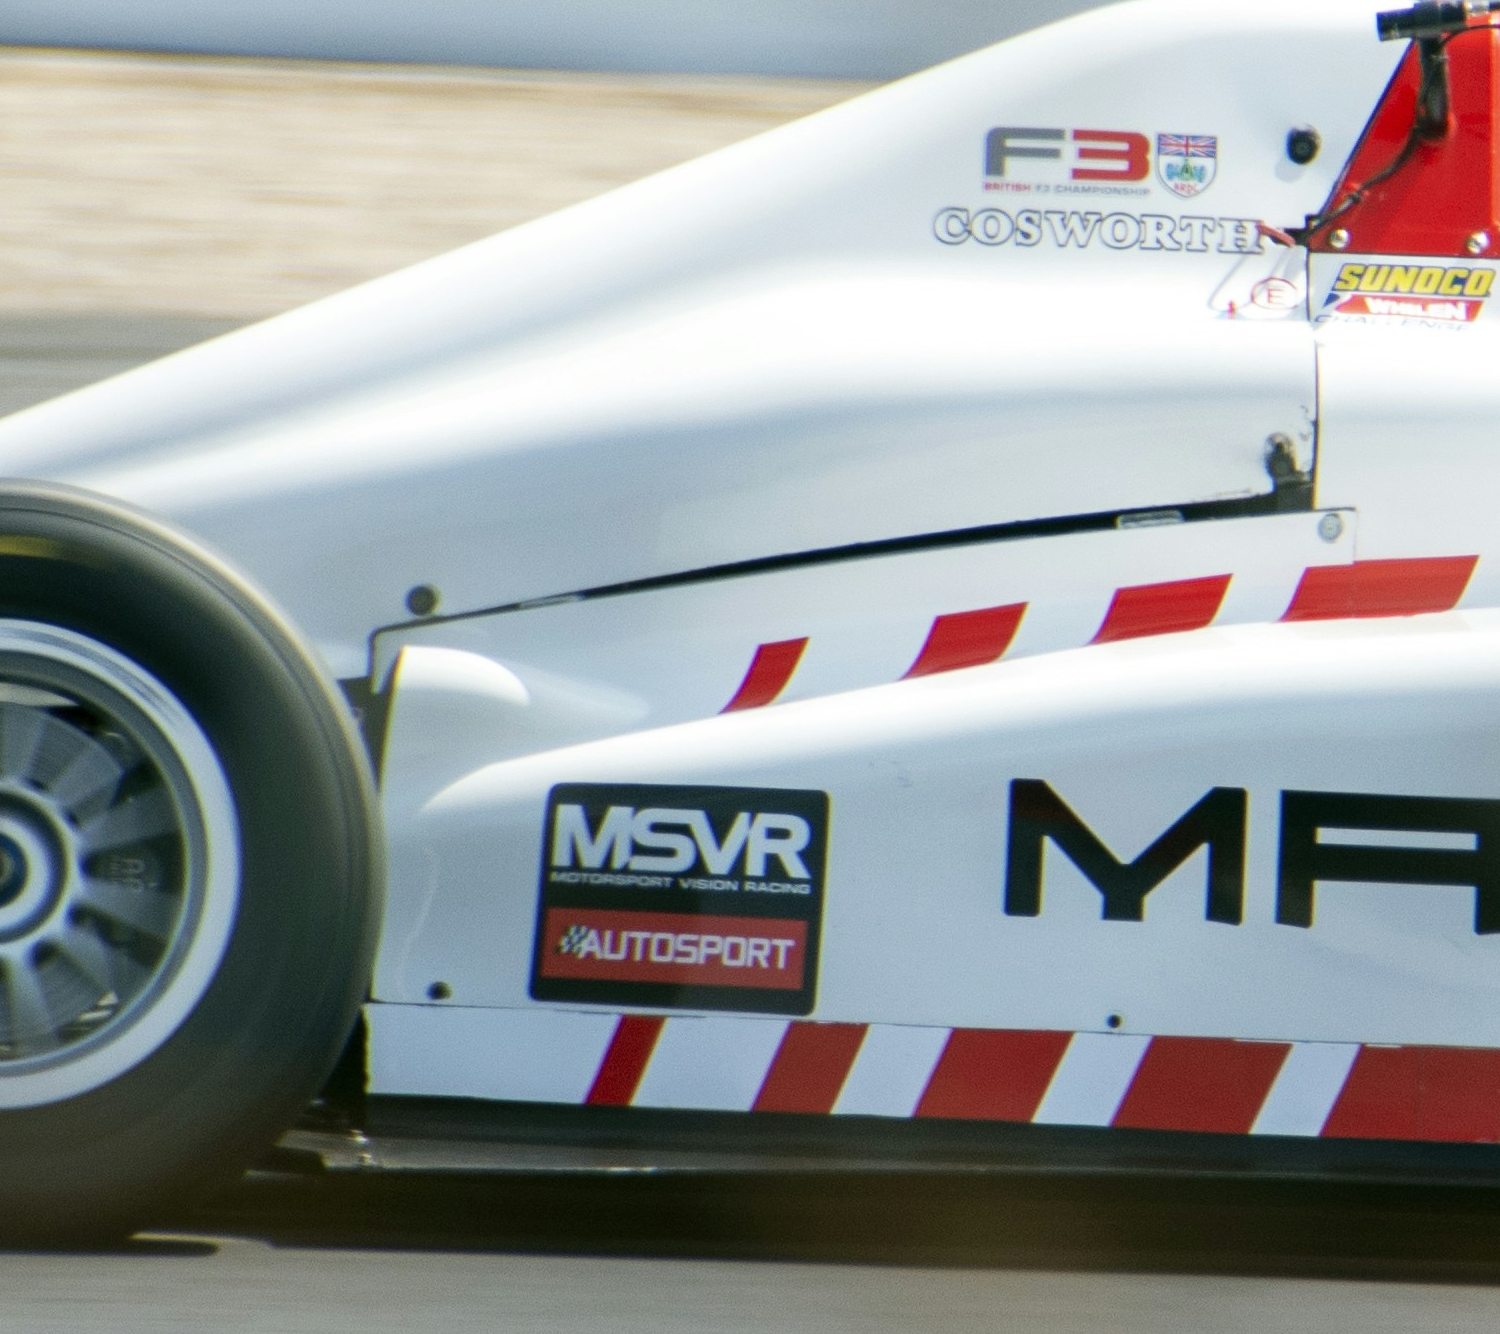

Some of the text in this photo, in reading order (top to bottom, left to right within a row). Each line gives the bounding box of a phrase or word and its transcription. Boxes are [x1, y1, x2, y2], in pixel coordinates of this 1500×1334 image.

[984, 127, 1151, 181] F3
[983, 181, 1032, 193] BRITISH
[1054, 184, 1151, 197] CHAMPIONSHIP
[933, 207, 1264, 255] COSWORTH
[1331, 262, 1497, 298] SUNOCO
[551, 803, 812, 879] MSVR
[551, 871, 812, 895] MOTORSPORT VISION RACING
[576, 927, 796, 971] AUTOSPORT
